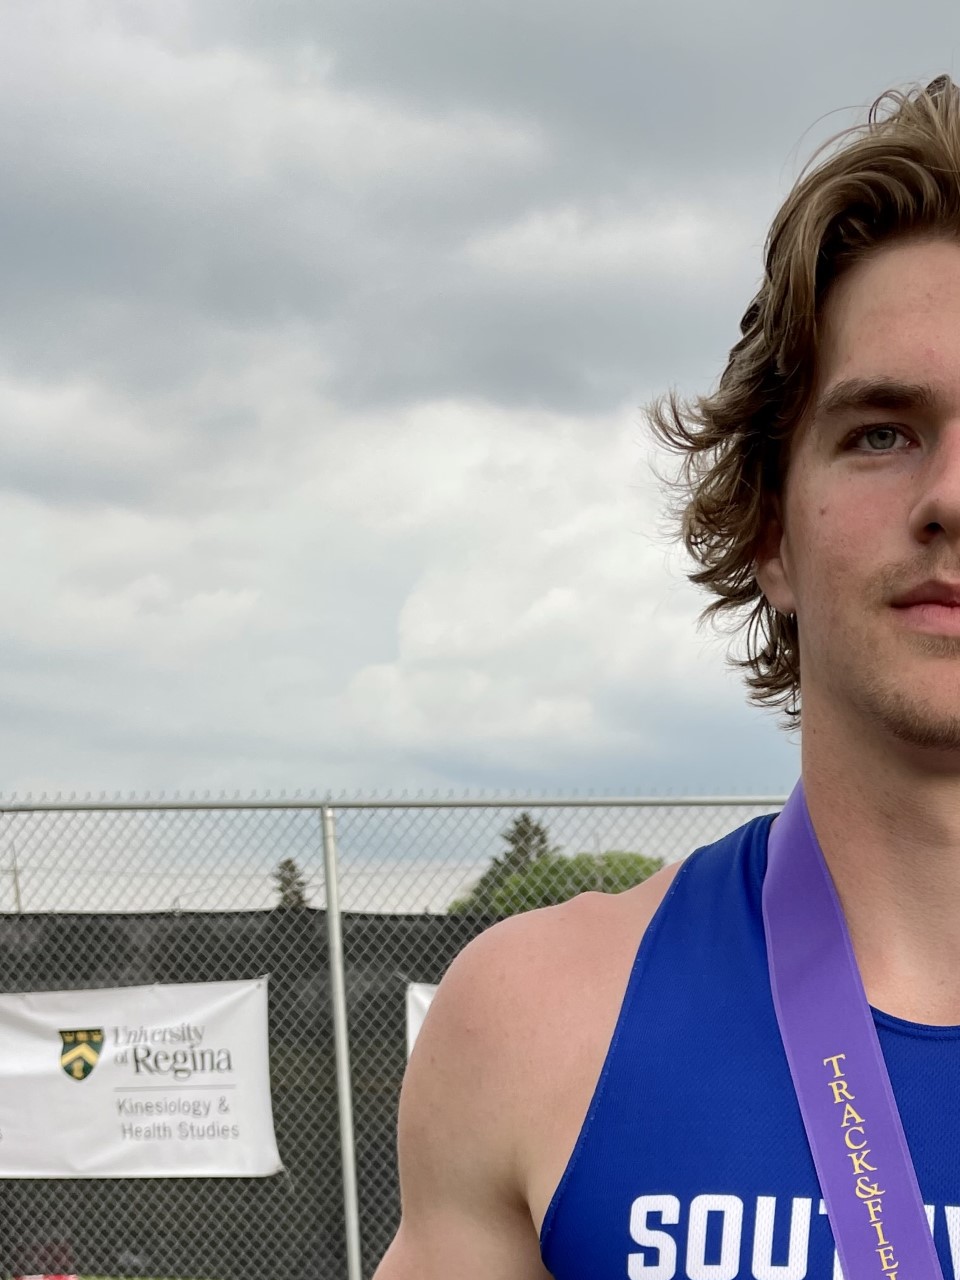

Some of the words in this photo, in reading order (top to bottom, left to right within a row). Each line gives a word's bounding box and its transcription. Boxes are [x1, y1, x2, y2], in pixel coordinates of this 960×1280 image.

[113, 1023, 206, 1046] University
[114, 1049, 129, 1066] of
[133, 1045, 233, 1079] Regina
[117, 1096, 211, 1116] Kinesiology
[218, 1097, 229, 1113] &
[122, 1122, 172, 1140] Health
[178, 1121, 240, 1140] Studies
